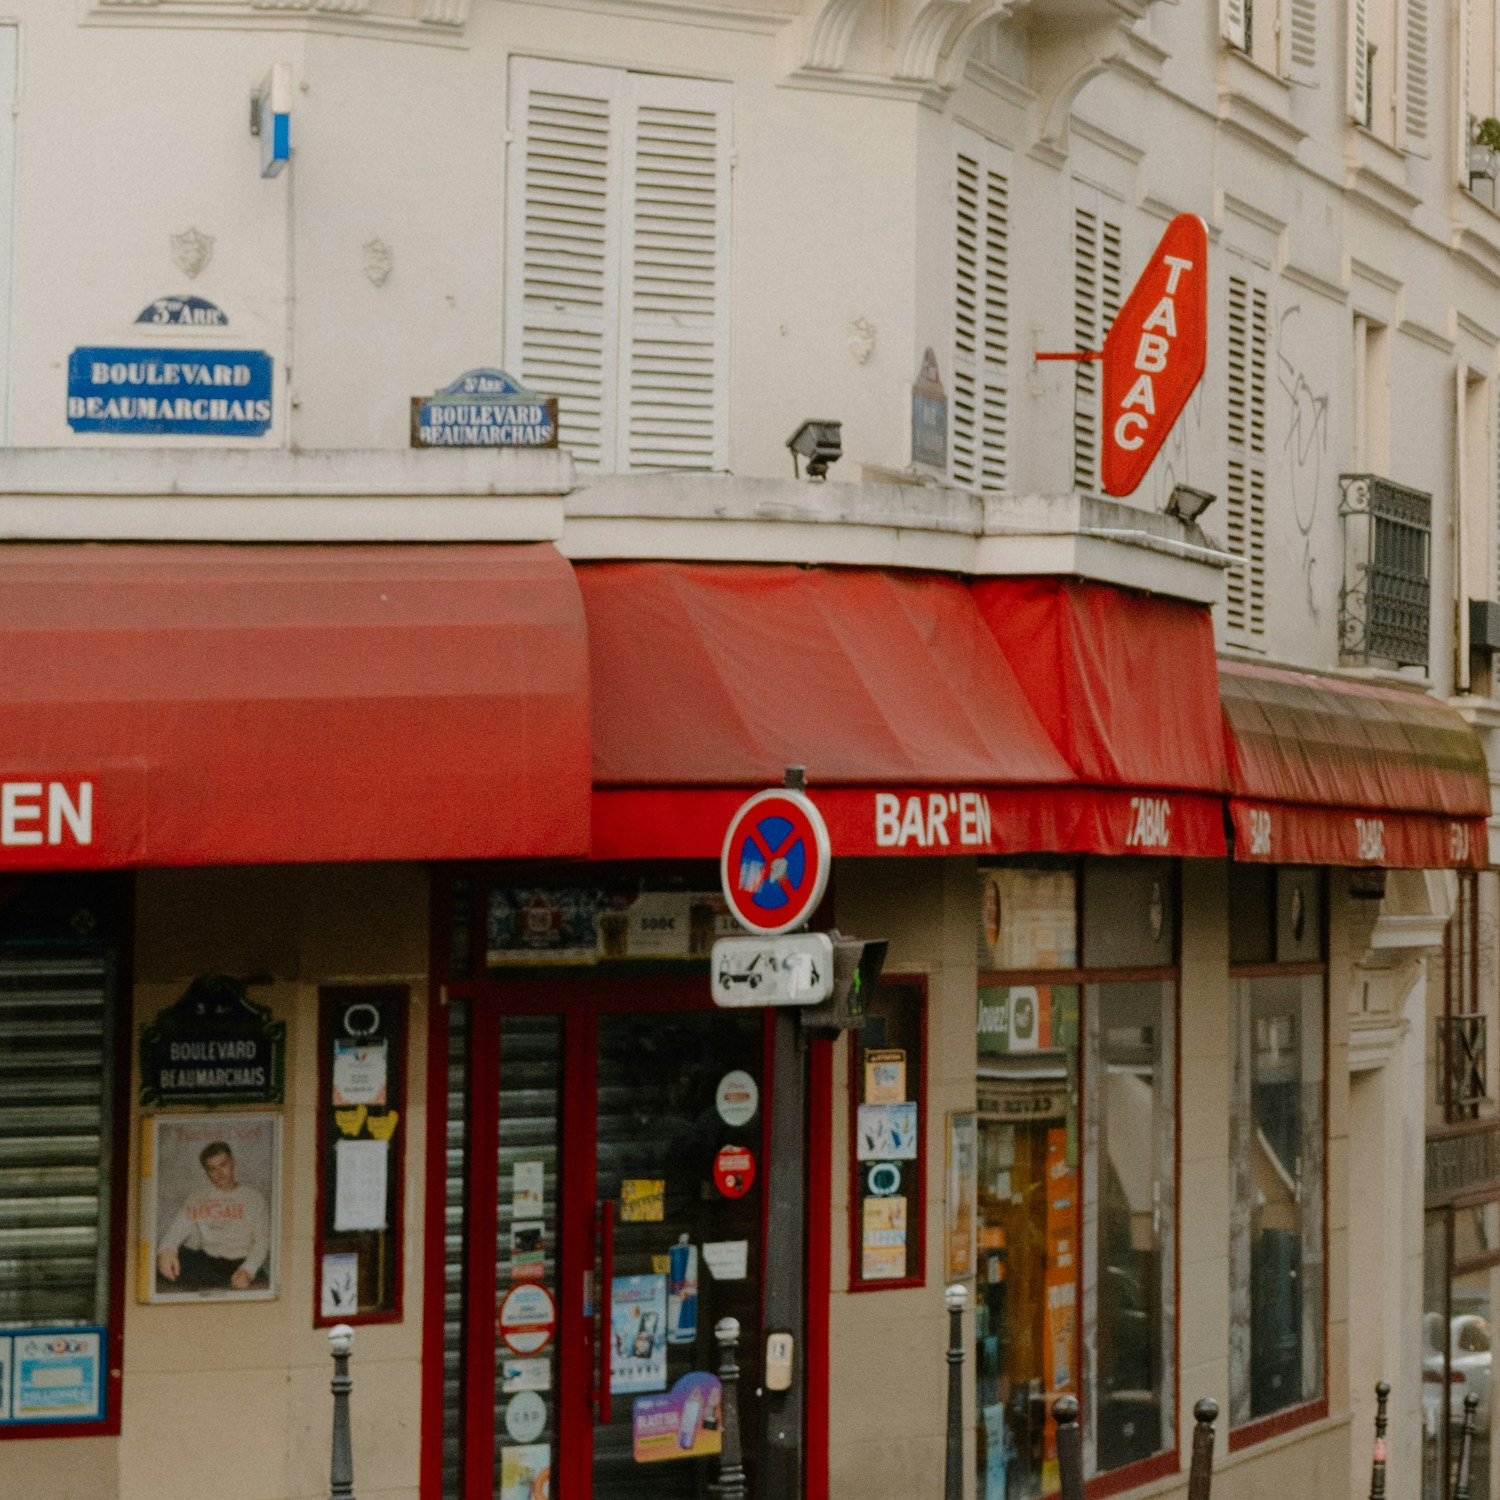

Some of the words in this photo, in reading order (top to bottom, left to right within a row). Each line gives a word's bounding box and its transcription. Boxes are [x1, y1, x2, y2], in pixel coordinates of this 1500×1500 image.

[1113, 254, 1193, 451] TABAC
[91, 362, 251, 386] BOULEVARD
[67, 397, 272, 421] BEAUMARCHAIS
[430, 405, 543, 426] BOULEVARD
[419, 425, 552, 445] BEAUMARCHAIS
[876, 792, 991, 847] BAR'EN
[1126, 797, 1171, 847] TABAC
[170, 1040, 256, 1060] BOULEVARD
[160, 1067, 265, 1089] BEAUMARCHAIS
